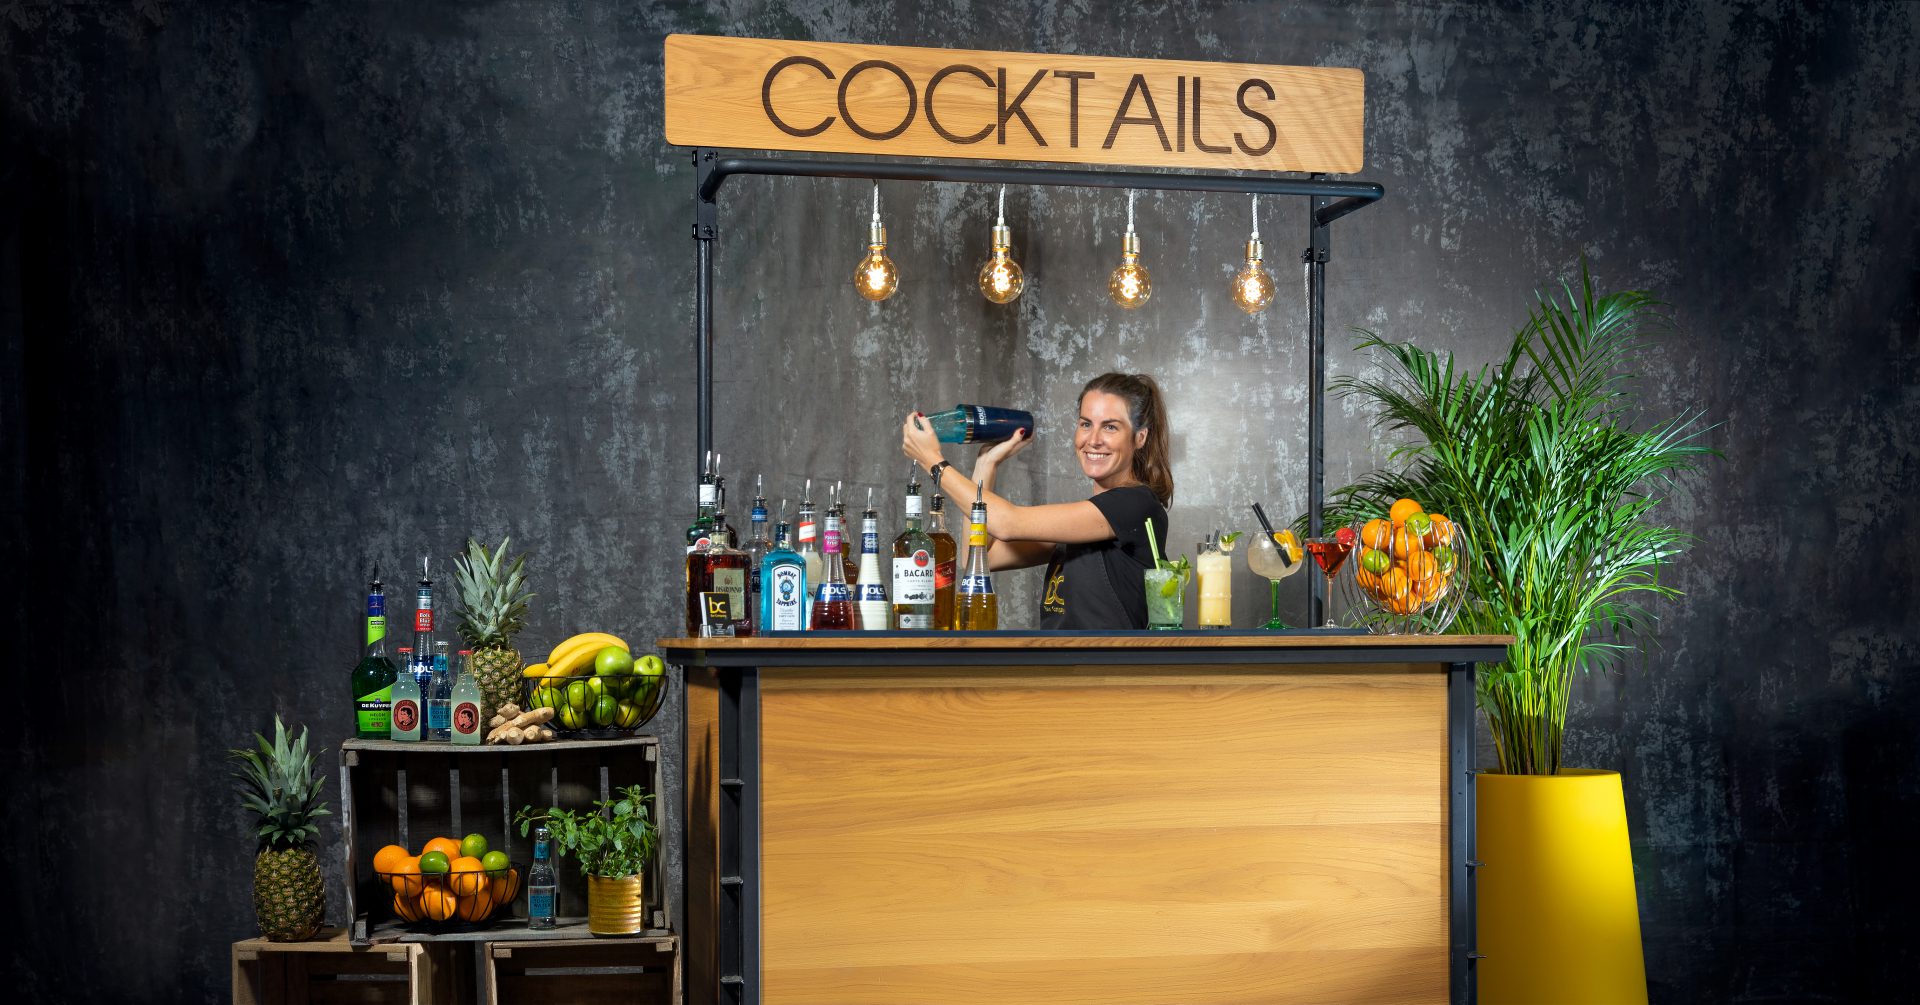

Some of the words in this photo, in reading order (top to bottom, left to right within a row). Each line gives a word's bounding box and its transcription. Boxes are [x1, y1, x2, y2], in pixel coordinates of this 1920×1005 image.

[761, 55, 1277, 157] COCKTAILS
[821, 586, 847, 595] BOLS
[708, 596, 727, 614] bc
